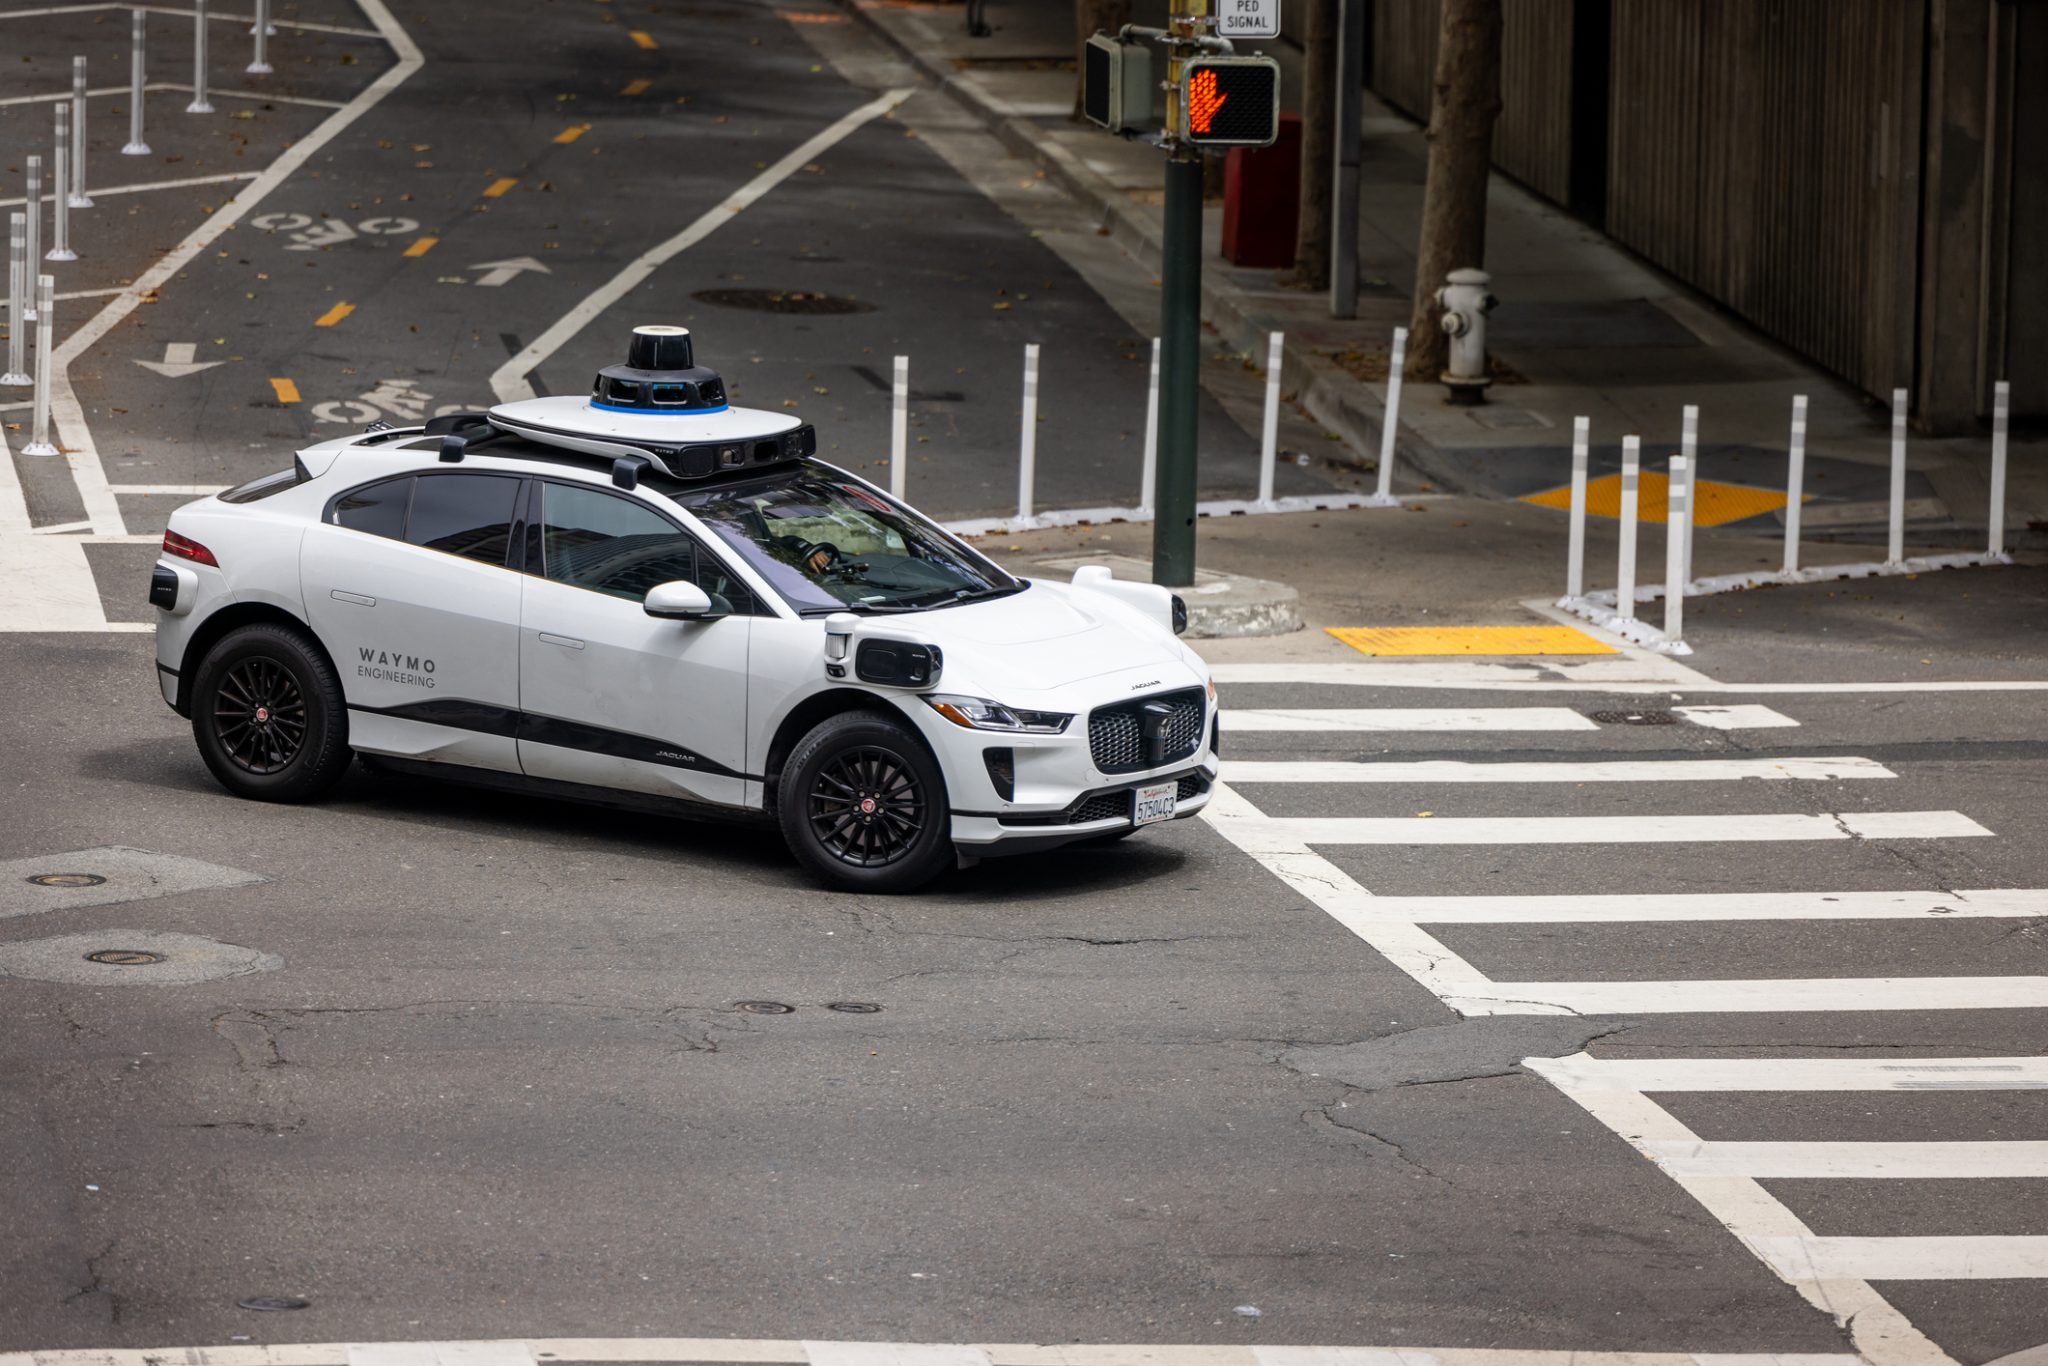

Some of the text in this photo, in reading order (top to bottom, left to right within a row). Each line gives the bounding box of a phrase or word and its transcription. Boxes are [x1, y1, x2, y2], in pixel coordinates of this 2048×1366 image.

[1237, 0, 1259, 12] PED
[1227, 16, 1269, 28] SIGNAL
[359, 647, 435, 673] WAYMO
[357, 665, 436, 689] ENGINEERING
[656, 751, 696, 762] JAGUAR
[1137, 796, 1175, 820] 57504C3
